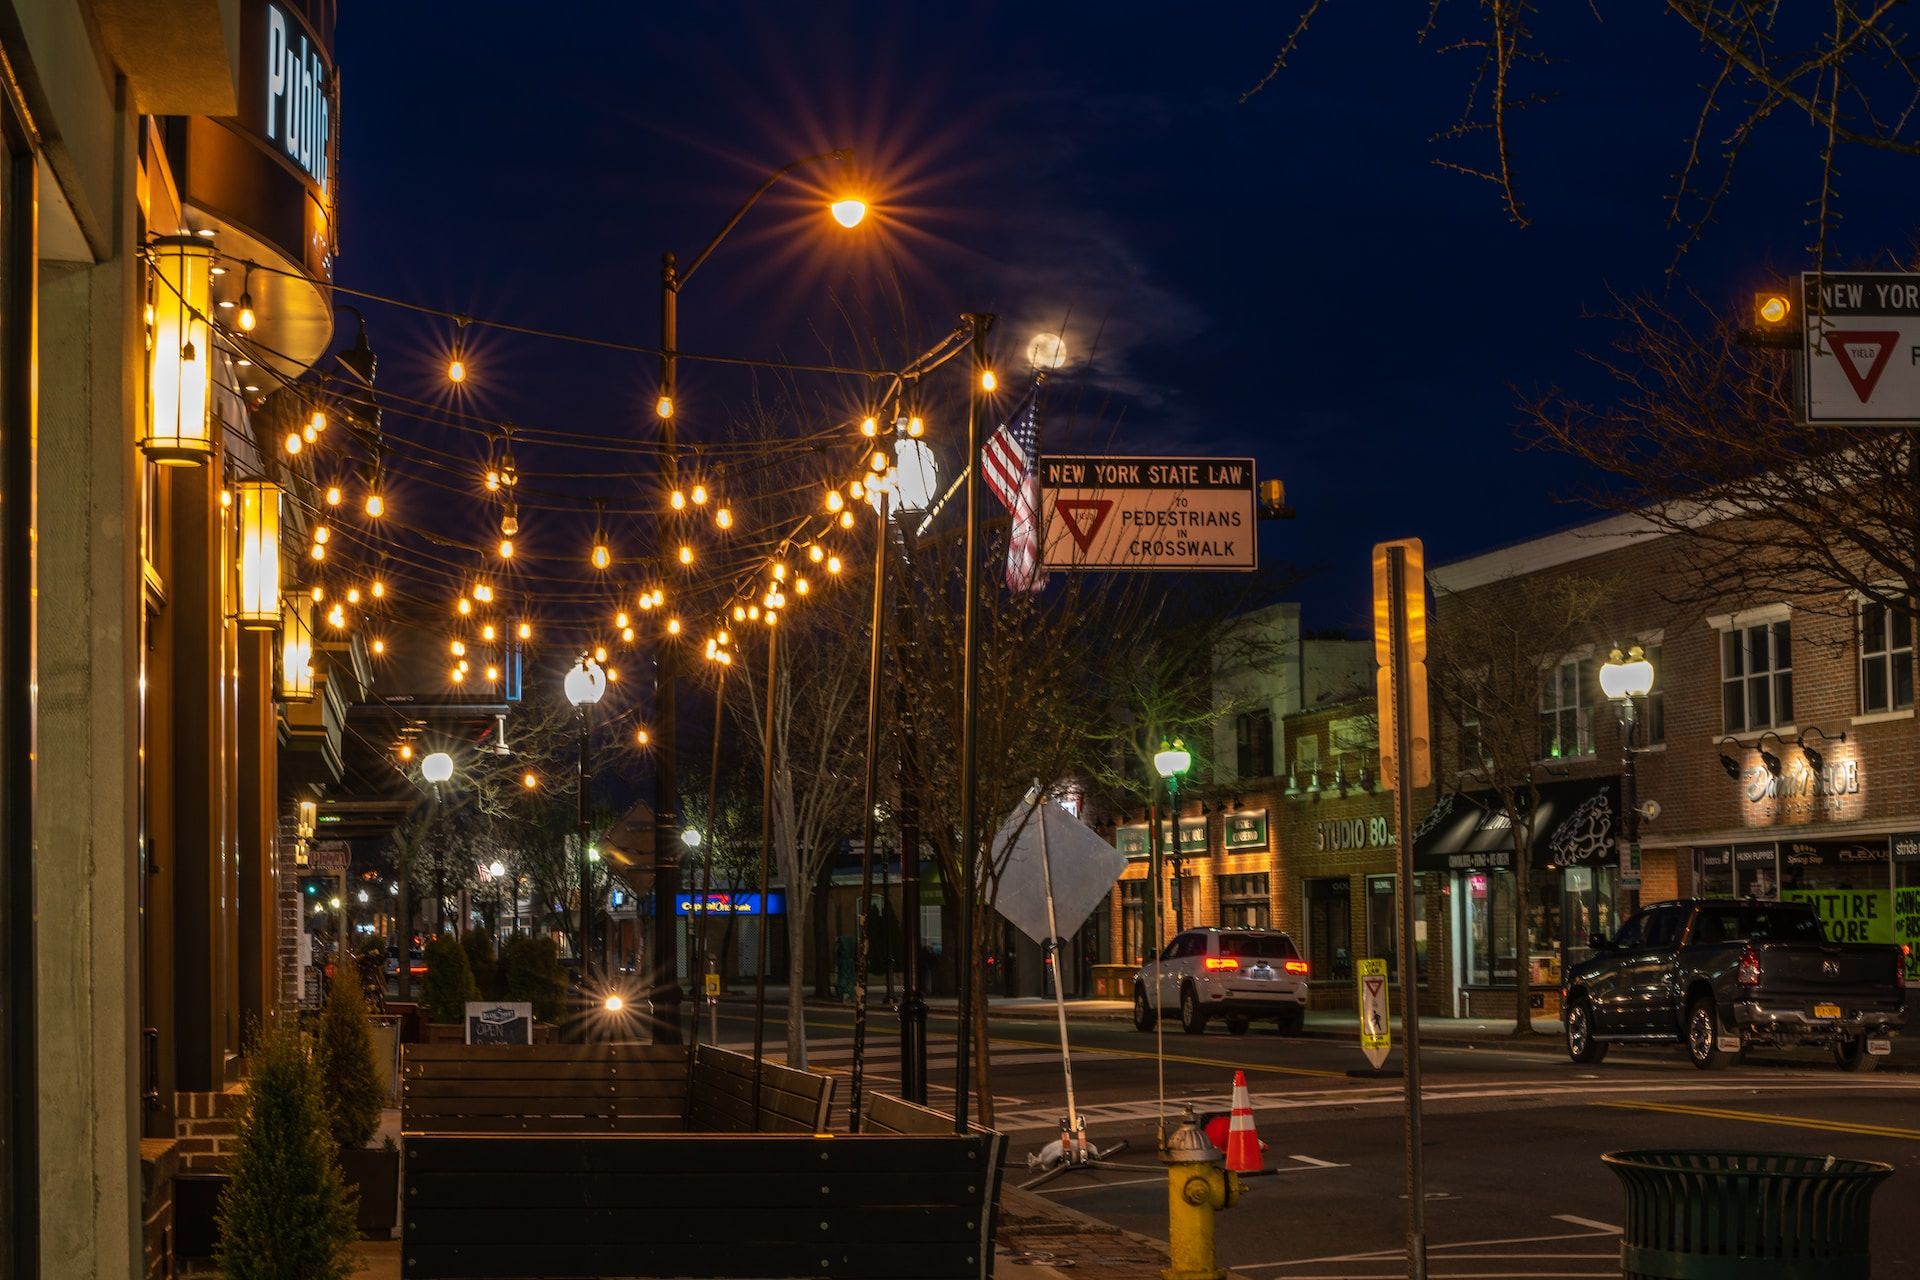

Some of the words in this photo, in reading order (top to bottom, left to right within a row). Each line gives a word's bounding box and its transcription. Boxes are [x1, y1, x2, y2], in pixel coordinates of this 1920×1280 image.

[267, 3, 329, 196] Public
[1821, 284, 1863, 308] NEW
[1851, 349, 1876, 359] YIELD
[1050, 464, 1086, 484] NEW
[1093, 465, 1141, 484] YORK
[1149, 465, 1199, 485] STATE
[1208, 466, 1243, 485] LAW
[1176, 498, 1188, 508] TO
[1121, 511, 1242, 528] PEDESTRIANS
[1177, 529, 1188, 539] IN
[1129, 541, 1236, 557] CROSSWALK
[1813, 760, 1860, 797] SHOE
[1317, 818, 1366, 852] STUDIO
[1370, 816, 1388, 848] 80
[1792, 894, 1878, 919] NTIRE
[476, 1022, 505, 1037] OPEN
